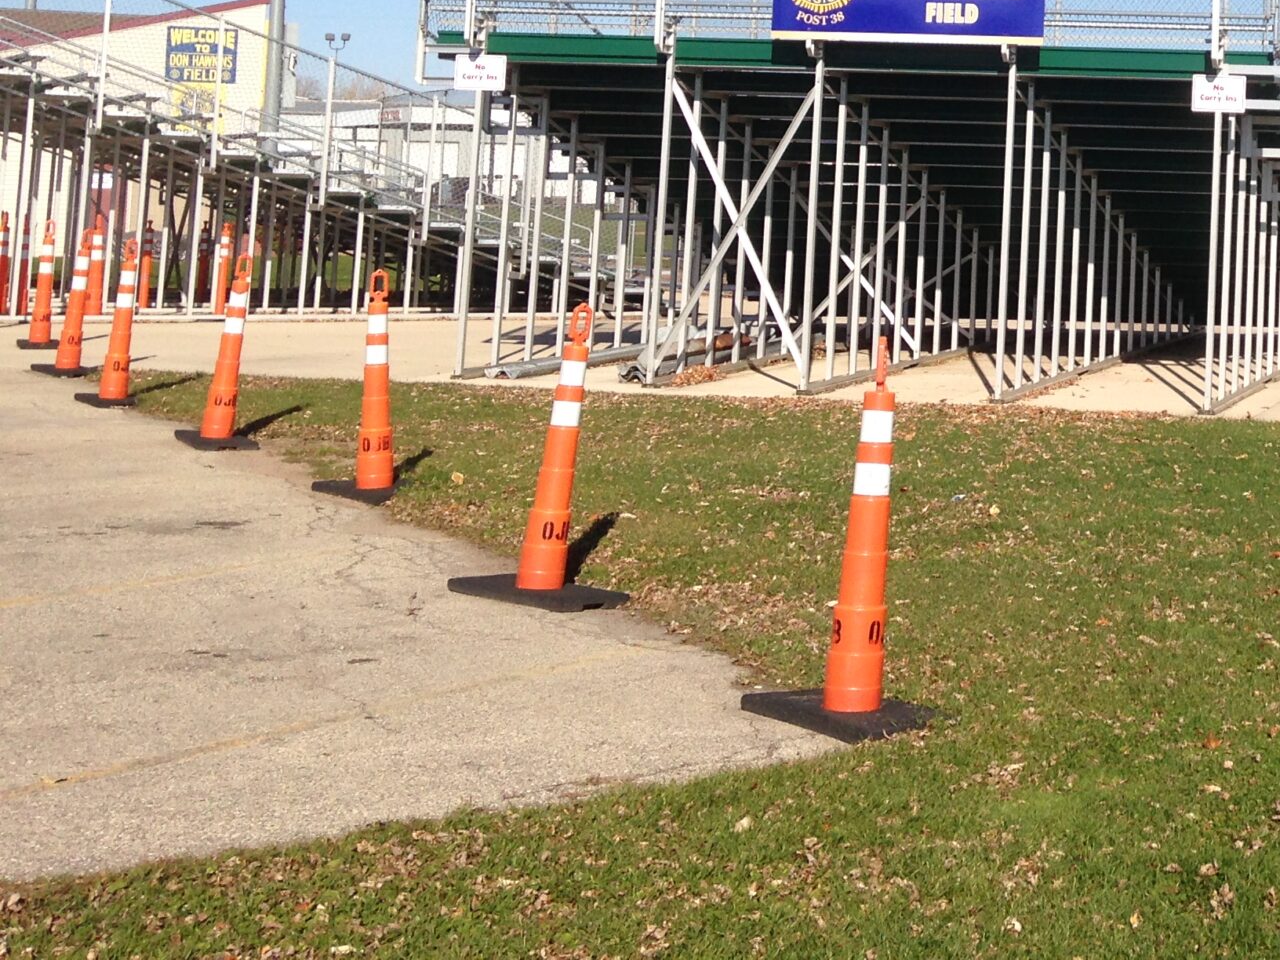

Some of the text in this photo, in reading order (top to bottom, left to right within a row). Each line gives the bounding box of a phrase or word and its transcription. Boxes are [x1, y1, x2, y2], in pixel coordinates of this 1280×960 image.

[796, 10, 845, 26] POST 38
[925, 2, 979, 24] FIELD
[195, 44, 210, 53] TO
[169, 53, 189, 68] DON
[184, 69, 218, 81] FIELD
